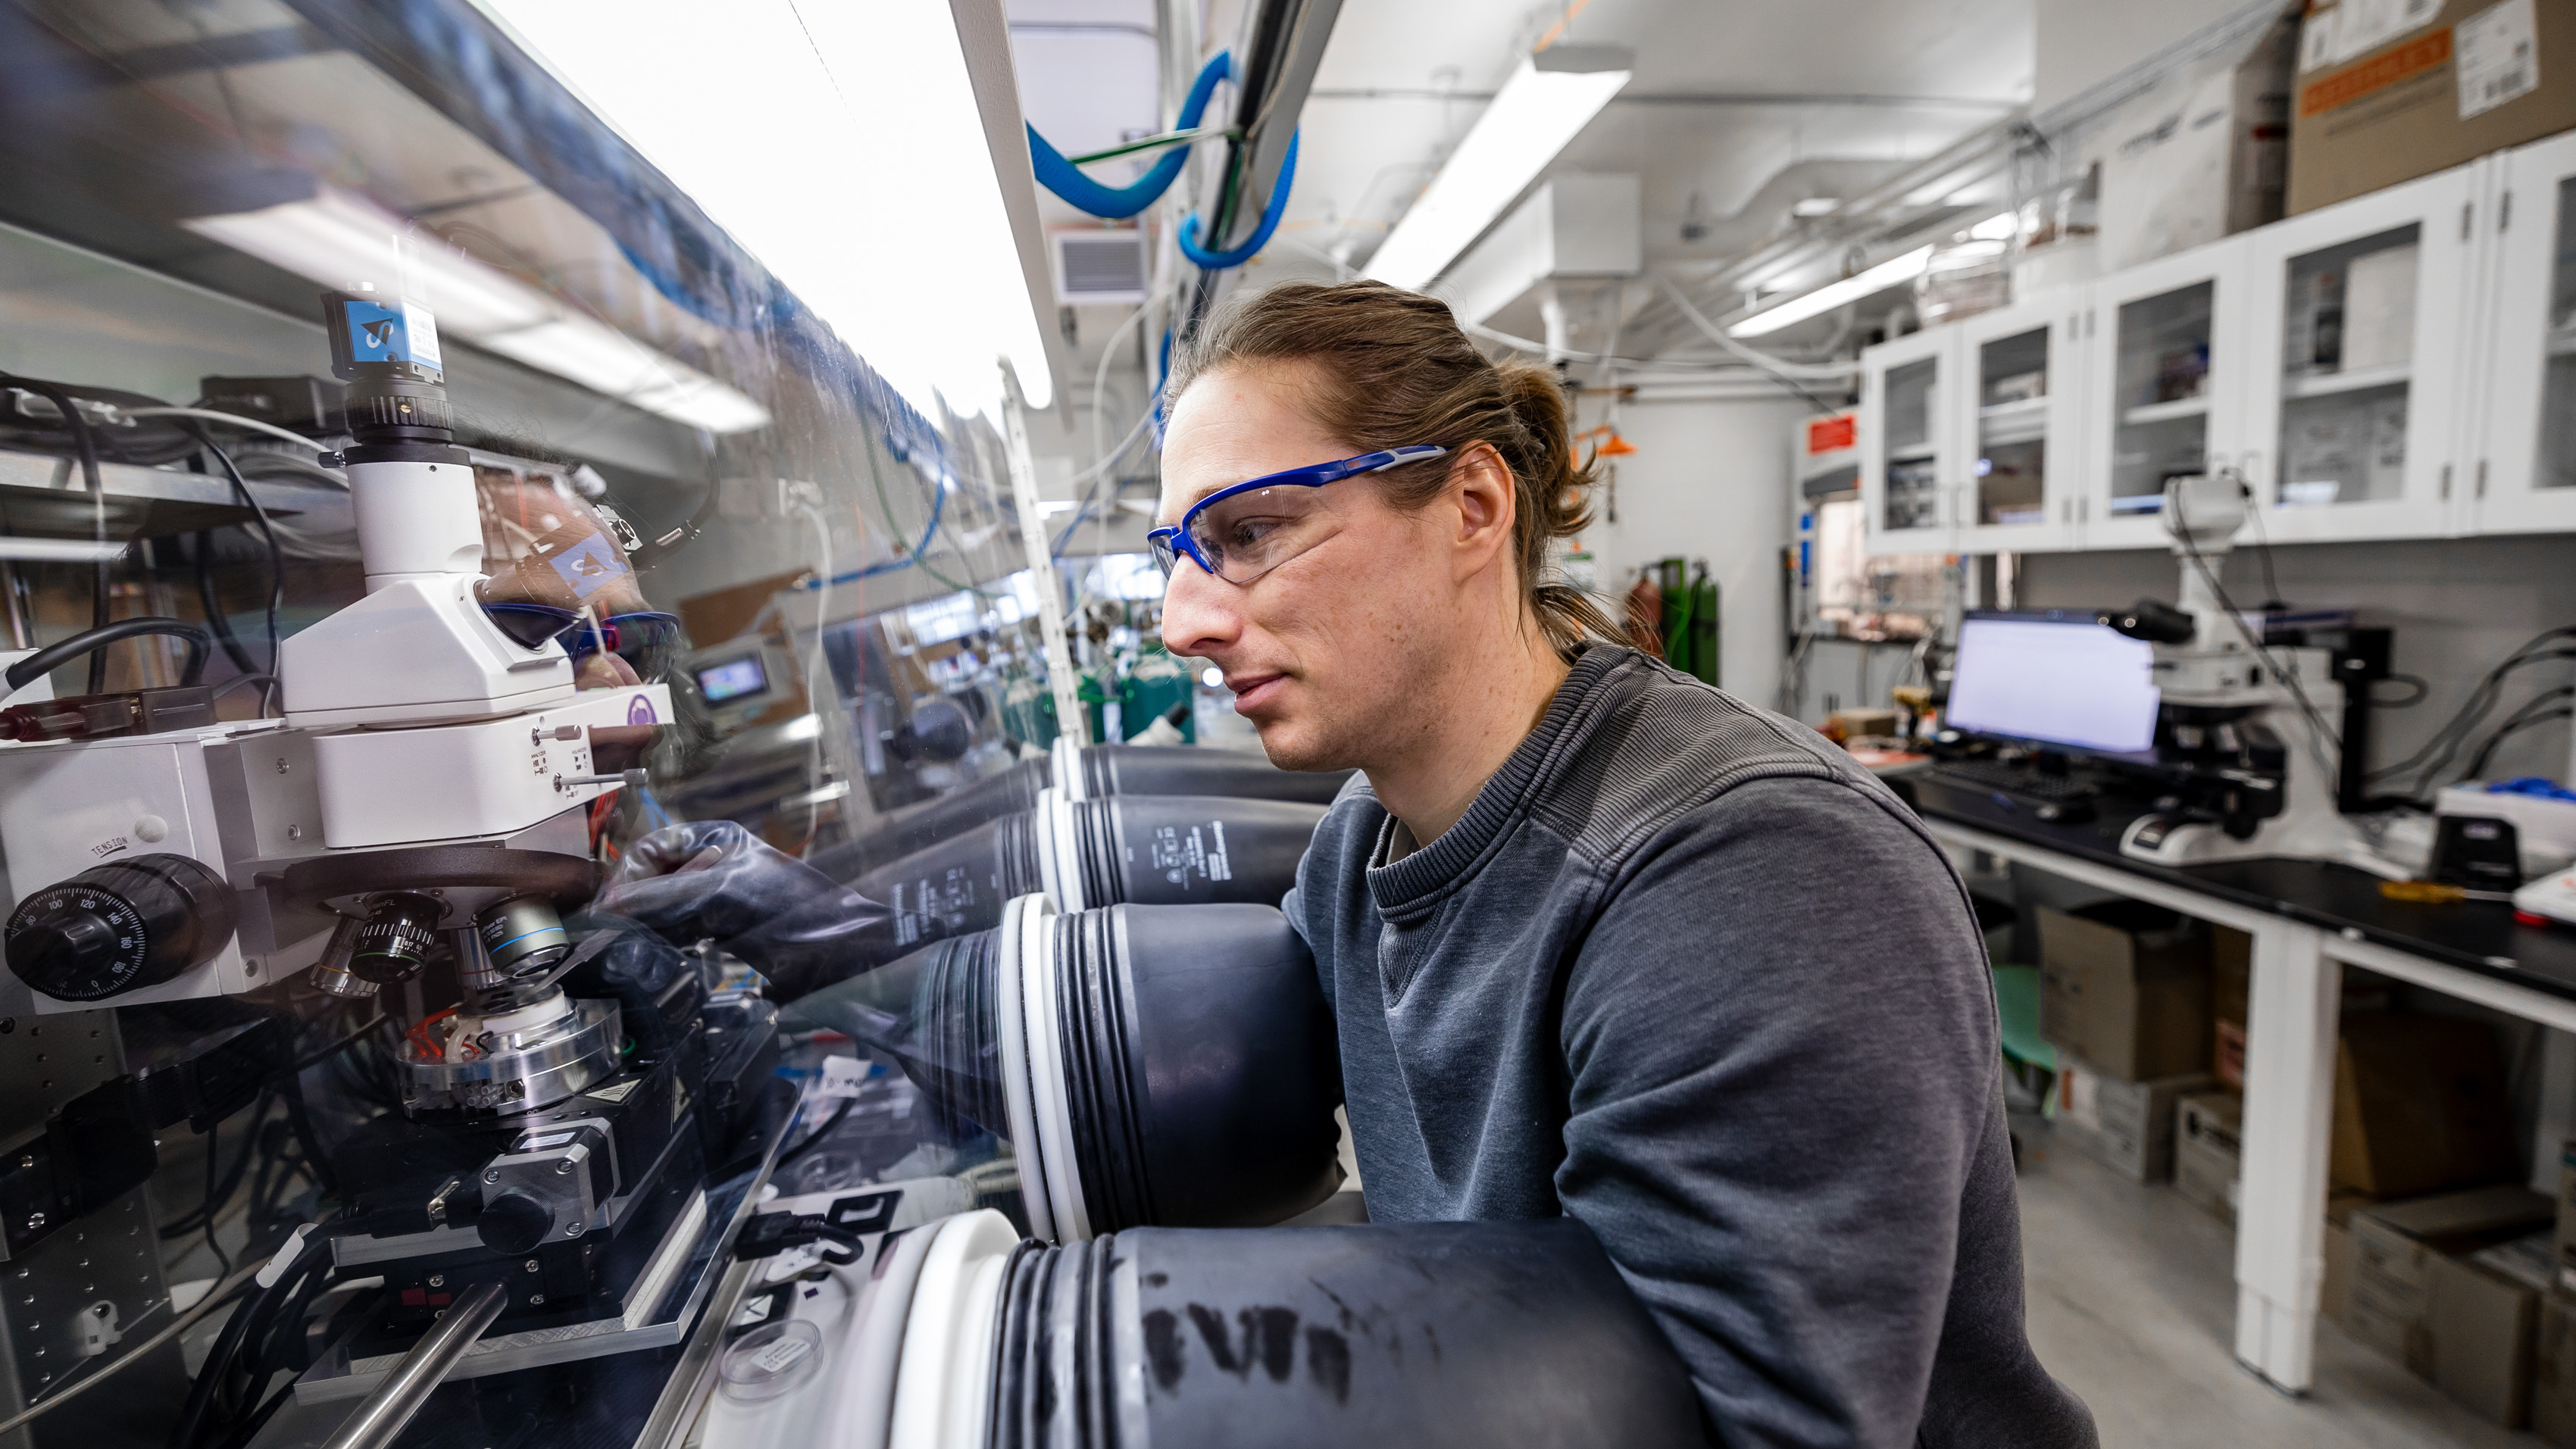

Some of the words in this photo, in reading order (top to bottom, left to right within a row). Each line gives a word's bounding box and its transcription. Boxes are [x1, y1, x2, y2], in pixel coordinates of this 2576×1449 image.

[91, 836, 128, 857] TENSION
[48, 898, 63, 910] 100
[80, 898, 95, 910] 120
[25, 915, 36, 926] 80
[106, 910, 122, 925] 140
[120, 936, 132, 949] 160
[112, 960, 126, 974] 180
